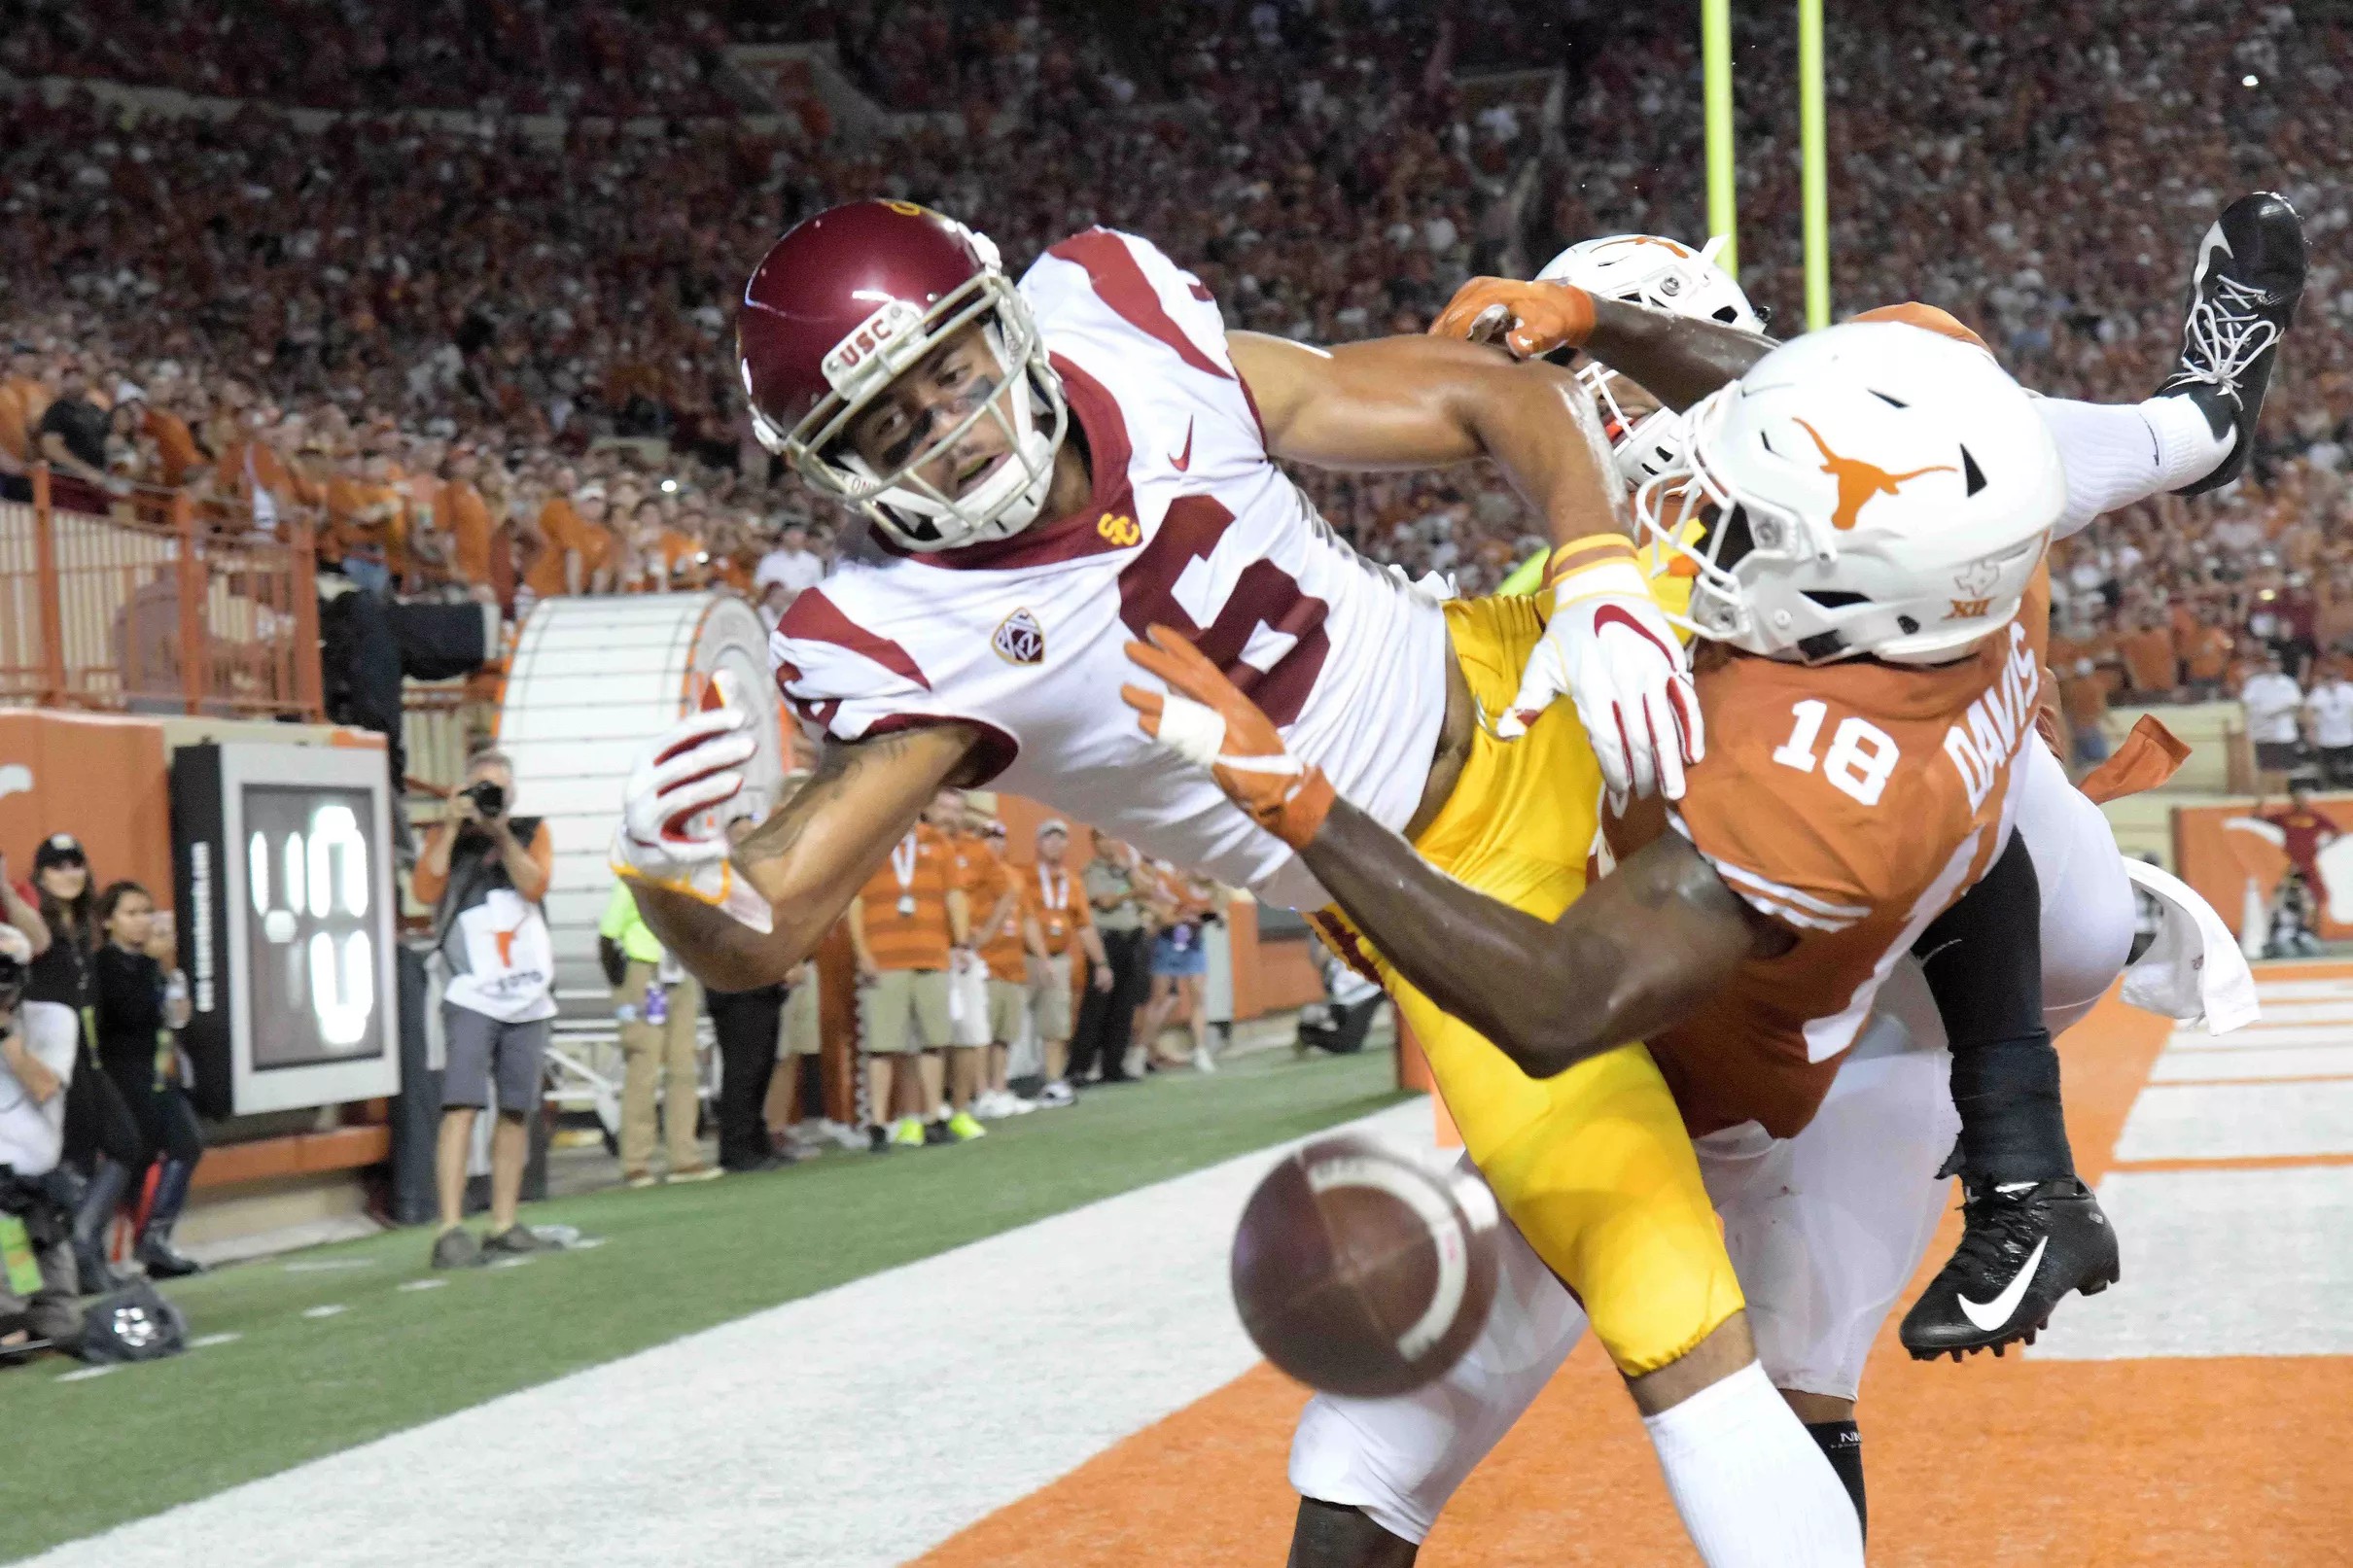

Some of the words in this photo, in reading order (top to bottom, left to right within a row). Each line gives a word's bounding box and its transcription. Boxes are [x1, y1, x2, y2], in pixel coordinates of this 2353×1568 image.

[839, 318, 893, 367] USC
[1117, 494, 1331, 729] 6
[1772, 699, 1900, 806] 18
[1943, 621, 2039, 815] DAVIS
